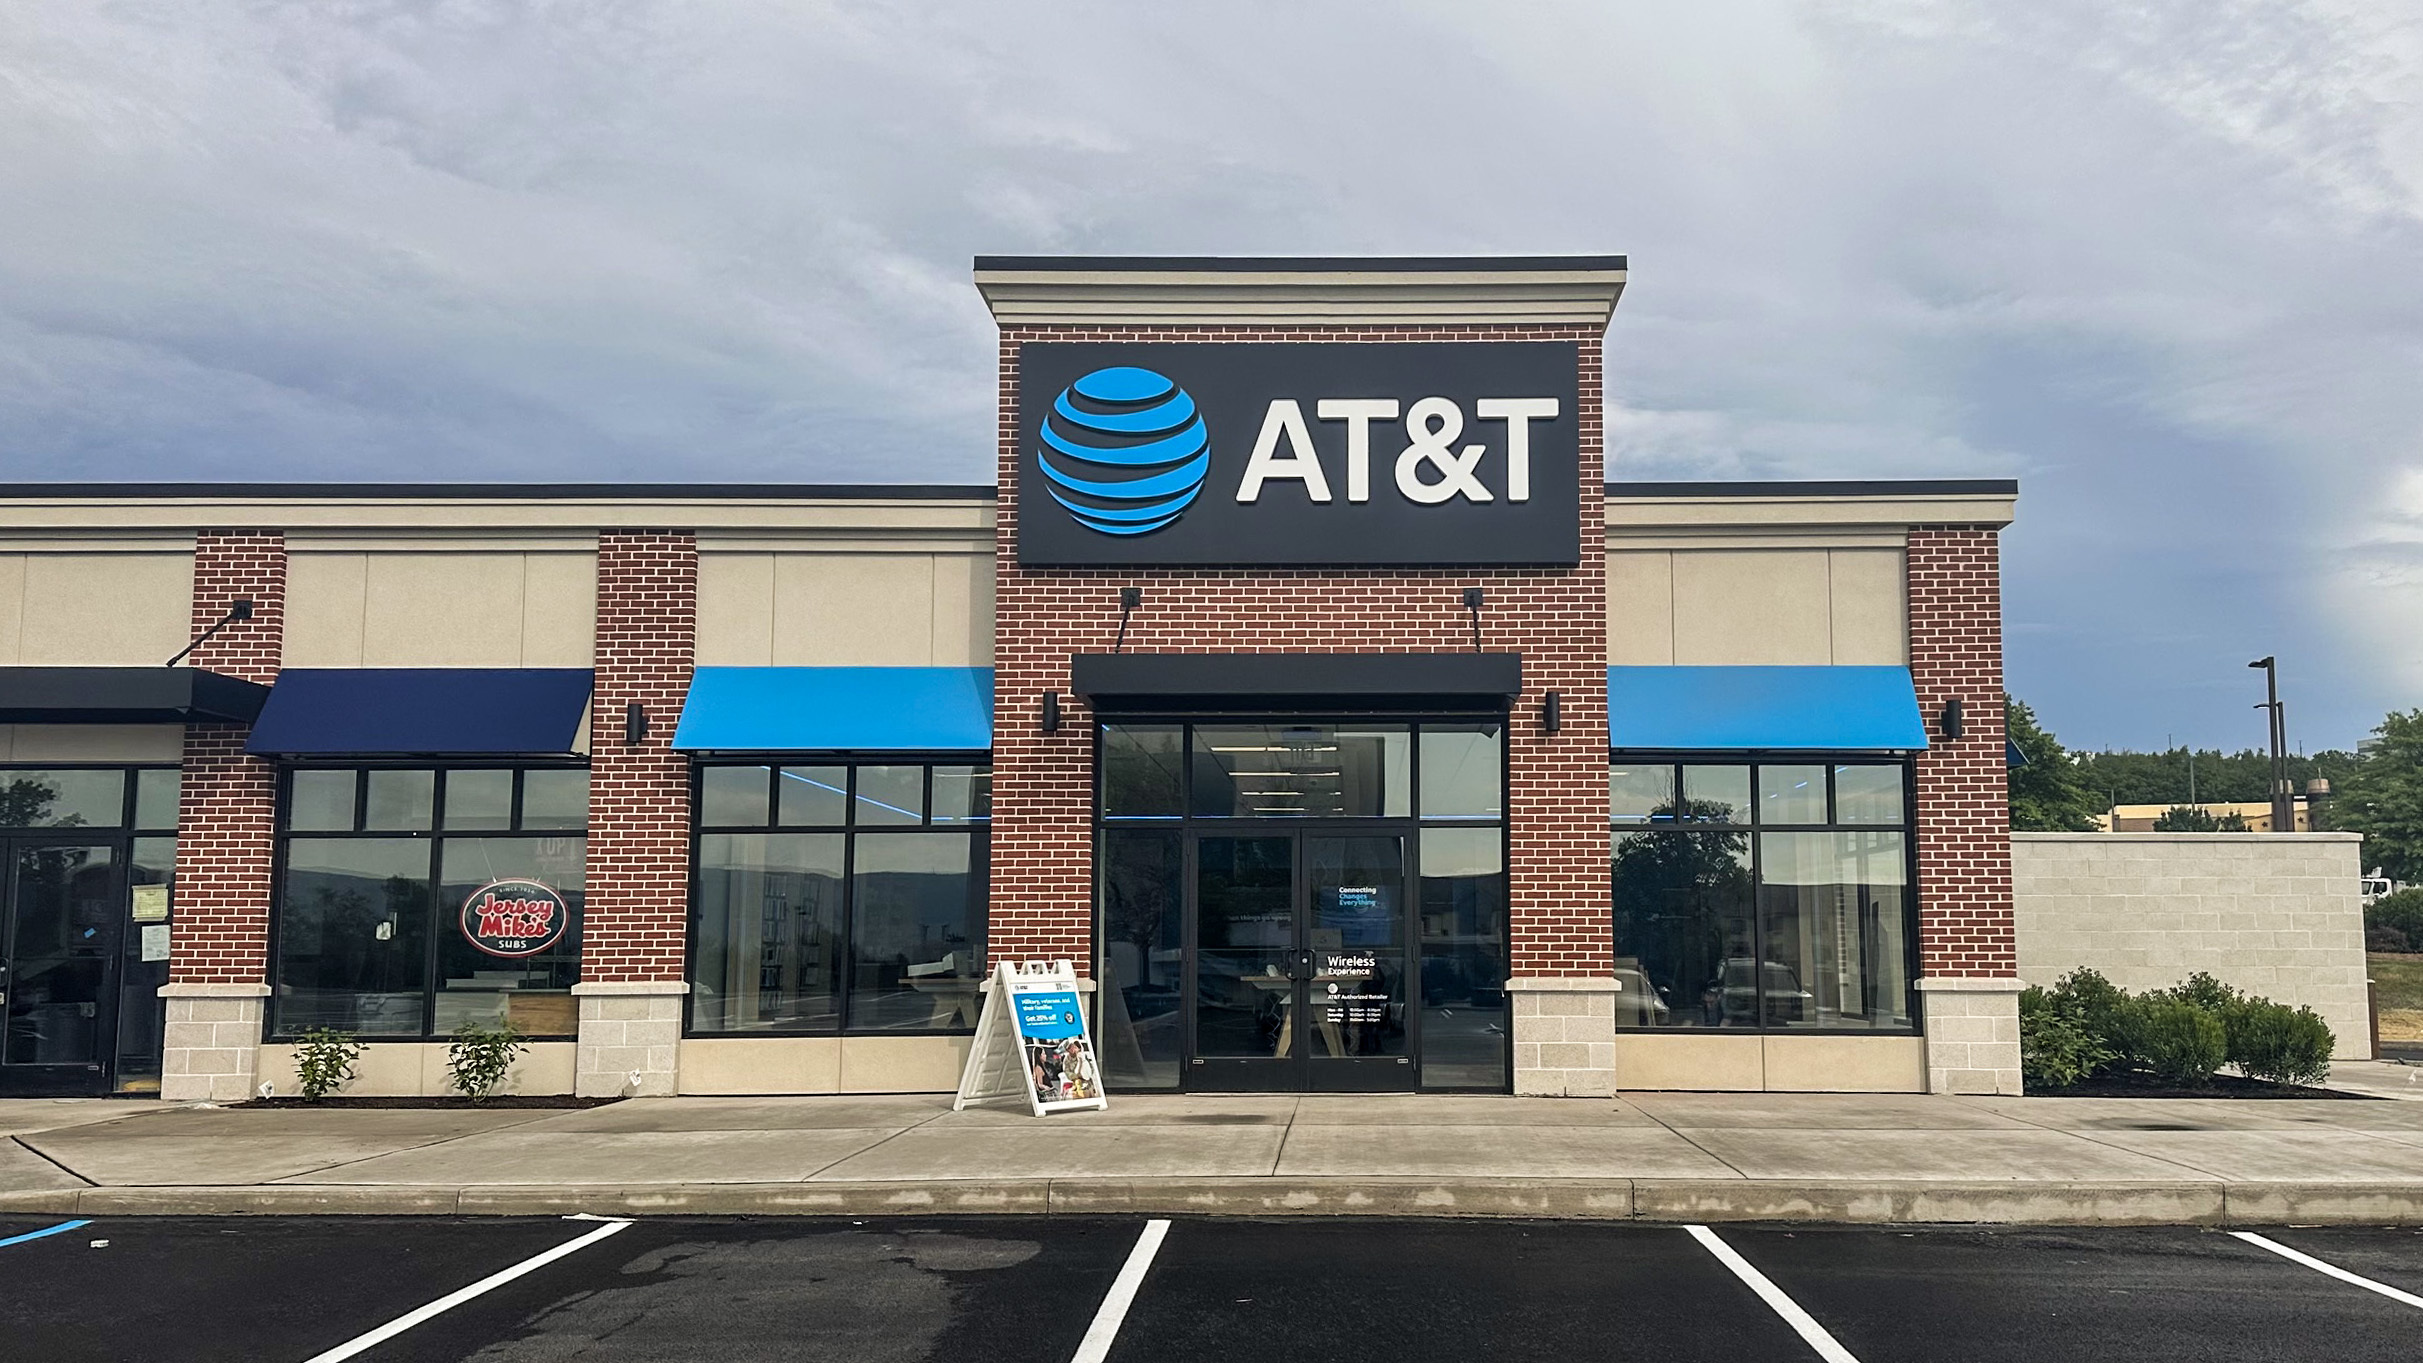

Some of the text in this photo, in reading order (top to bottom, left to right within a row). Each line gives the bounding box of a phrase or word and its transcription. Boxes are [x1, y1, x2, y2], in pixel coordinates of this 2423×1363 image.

[1235, 396, 1560, 504] AT&T
[1339, 886, 1377, 895] Connecting
[475, 892, 554, 921] Jersey
[1339, 899, 1377, 907] Everything
[478, 914, 551, 938] Mike's
[498, 940, 527, 949] SUBS
[1327, 955, 1376, 967] Wireless
[1327, 967, 1371, 976] Experience
